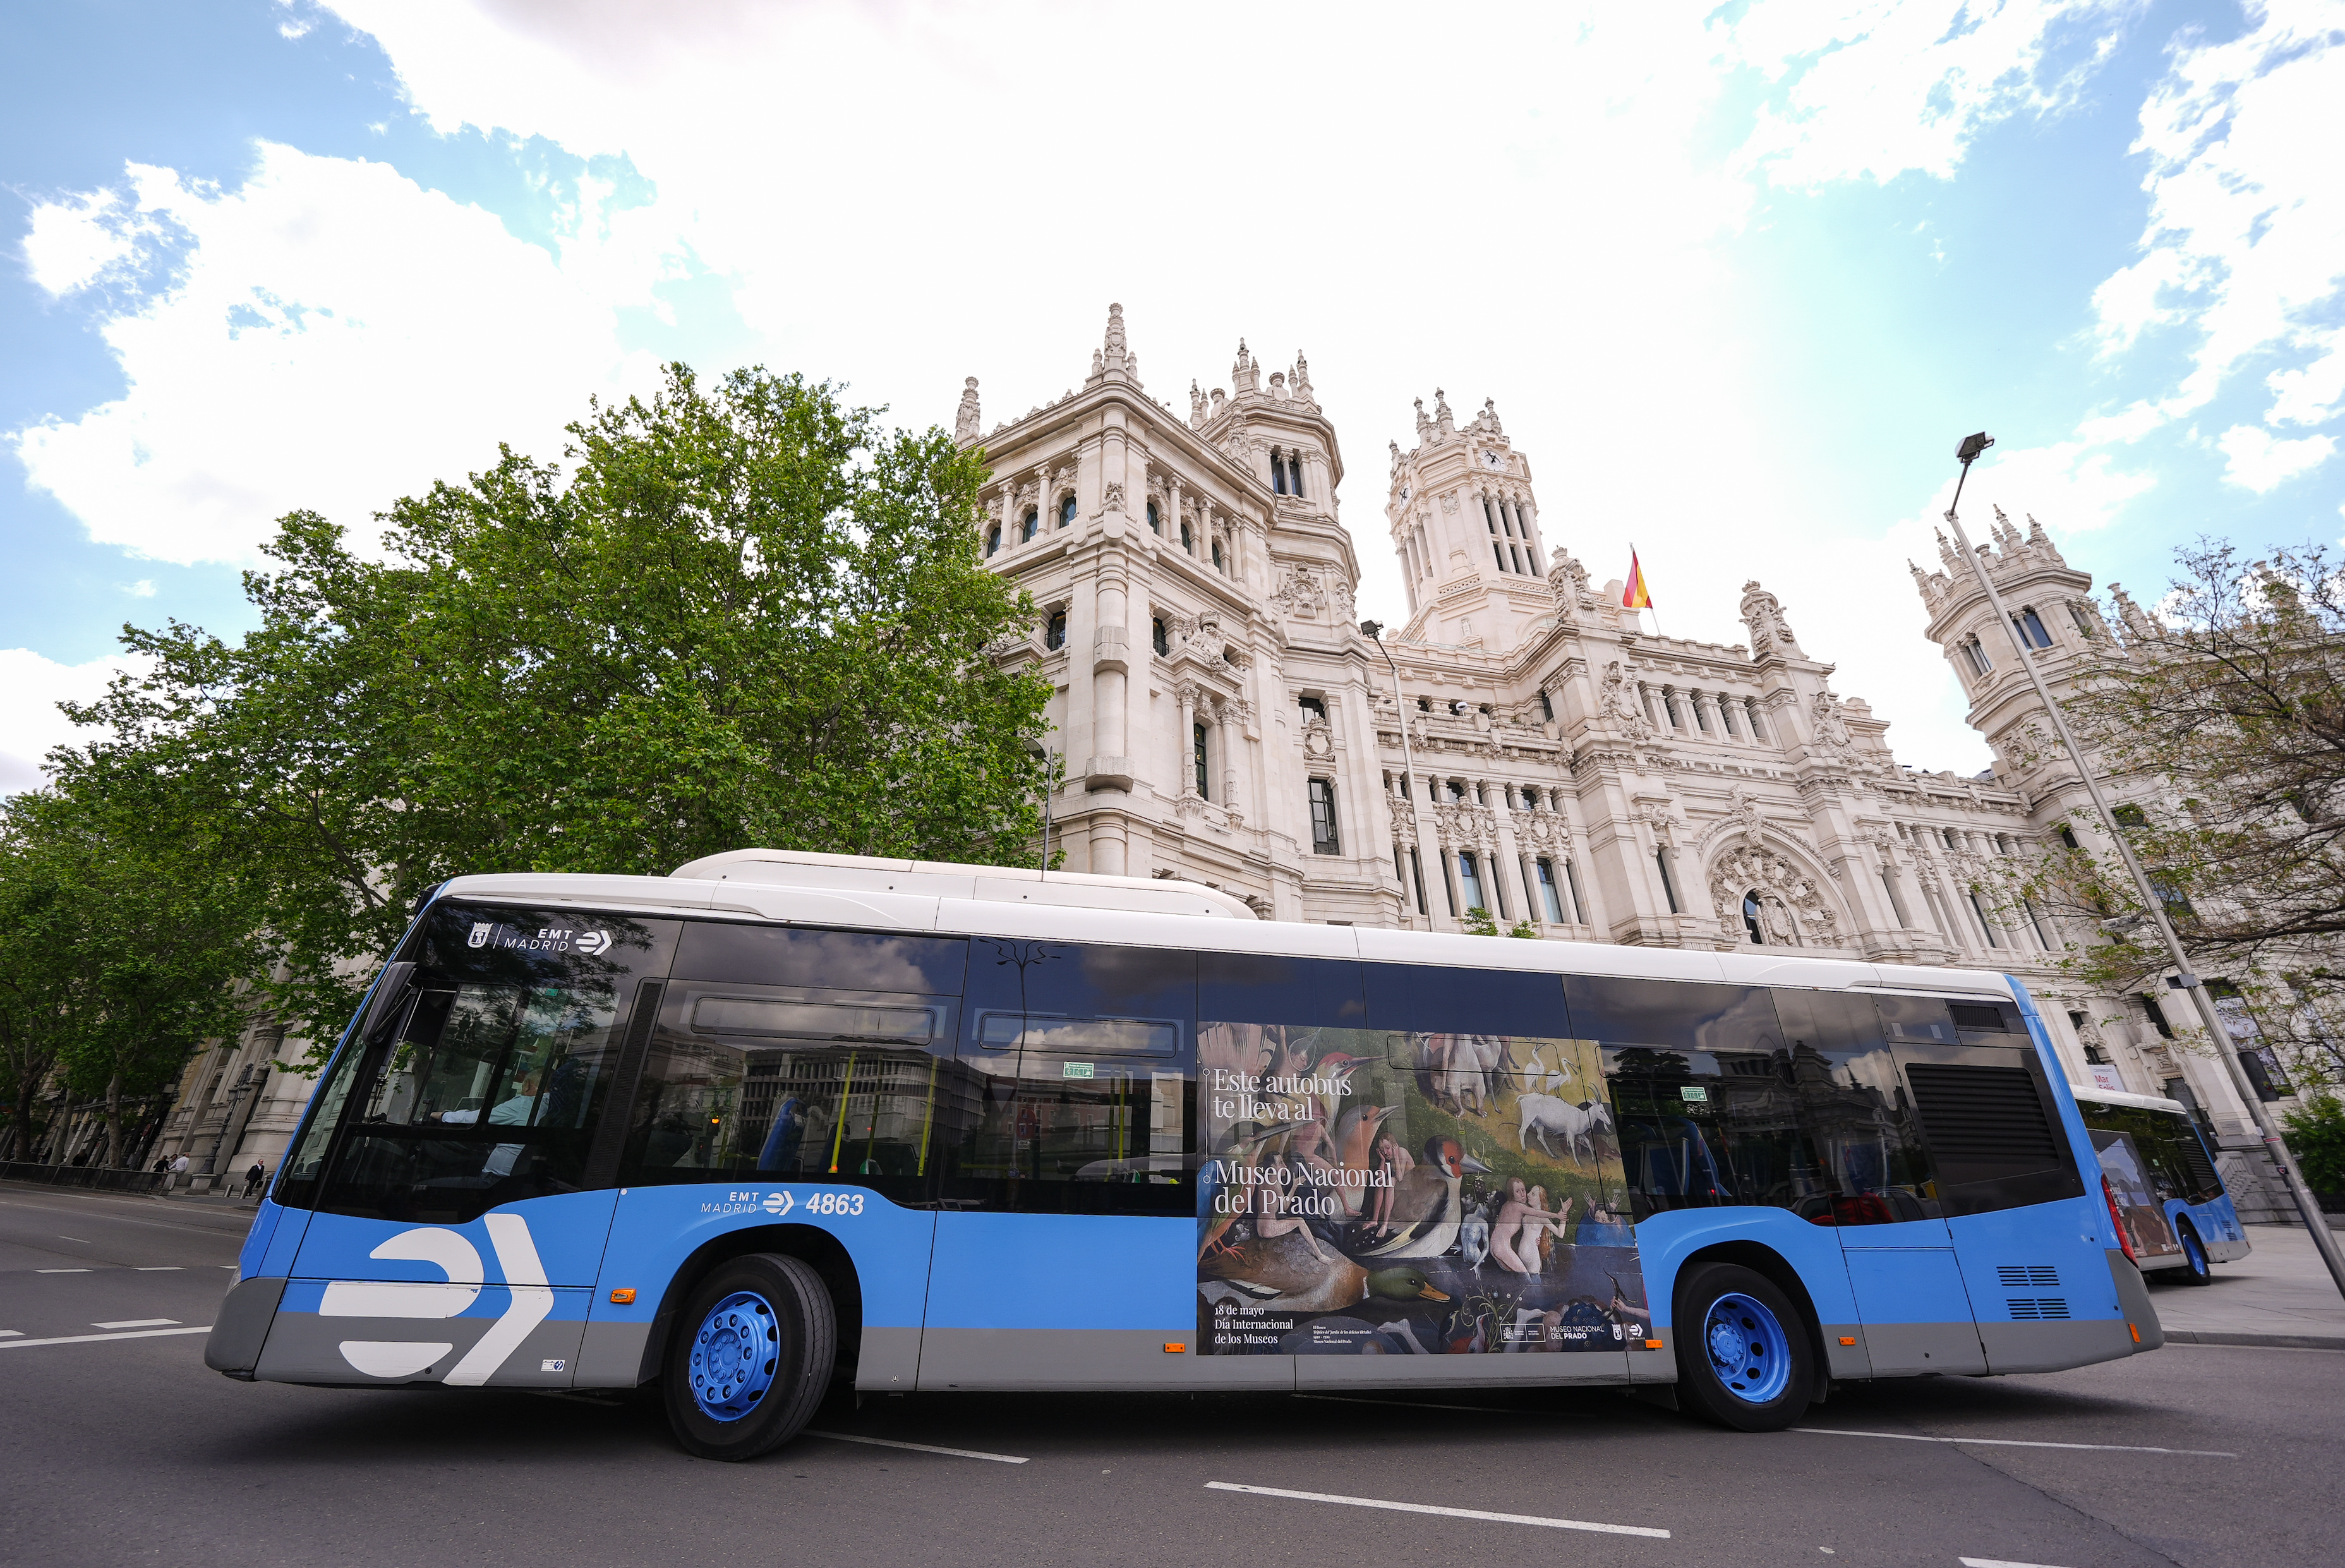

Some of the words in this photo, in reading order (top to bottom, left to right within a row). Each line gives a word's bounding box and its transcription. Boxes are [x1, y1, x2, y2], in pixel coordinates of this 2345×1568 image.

[538, 929, 573, 939] EMT
[504, 938, 569, 951] MADRID
[1214, 1068, 1261, 1093] Este
[1265, 1072, 1353, 1096] autobús
[1213, 1095, 1236, 1119] te
[1239, 1094, 1291, 1120] lleva
[1294, 1096, 1315, 1121] al
[1214, 1160, 1292, 1185] Museo
[1296, 1161, 1395, 1188] Nacional
[729, 1191, 759, 1202] EMT
[1214, 1186, 1254, 1214] del
[1261, 1188, 1335, 1215] Prado
[701, 1203, 757, 1214] MADRID
[805, 1193, 865, 1215] 4863
[1214, 1305, 1224, 1315] 18
[1226, 1305, 1238, 1315] de
[1239, 1306, 1265, 1317] mayo
[1214, 1318, 1231, 1329] Día
[1232, 1319, 1294, 1330] Internacional
[1214, 1333, 1227, 1344] de
[1228, 1334, 1242, 1344] los
[1243, 1334, 1278, 1344] Museos
